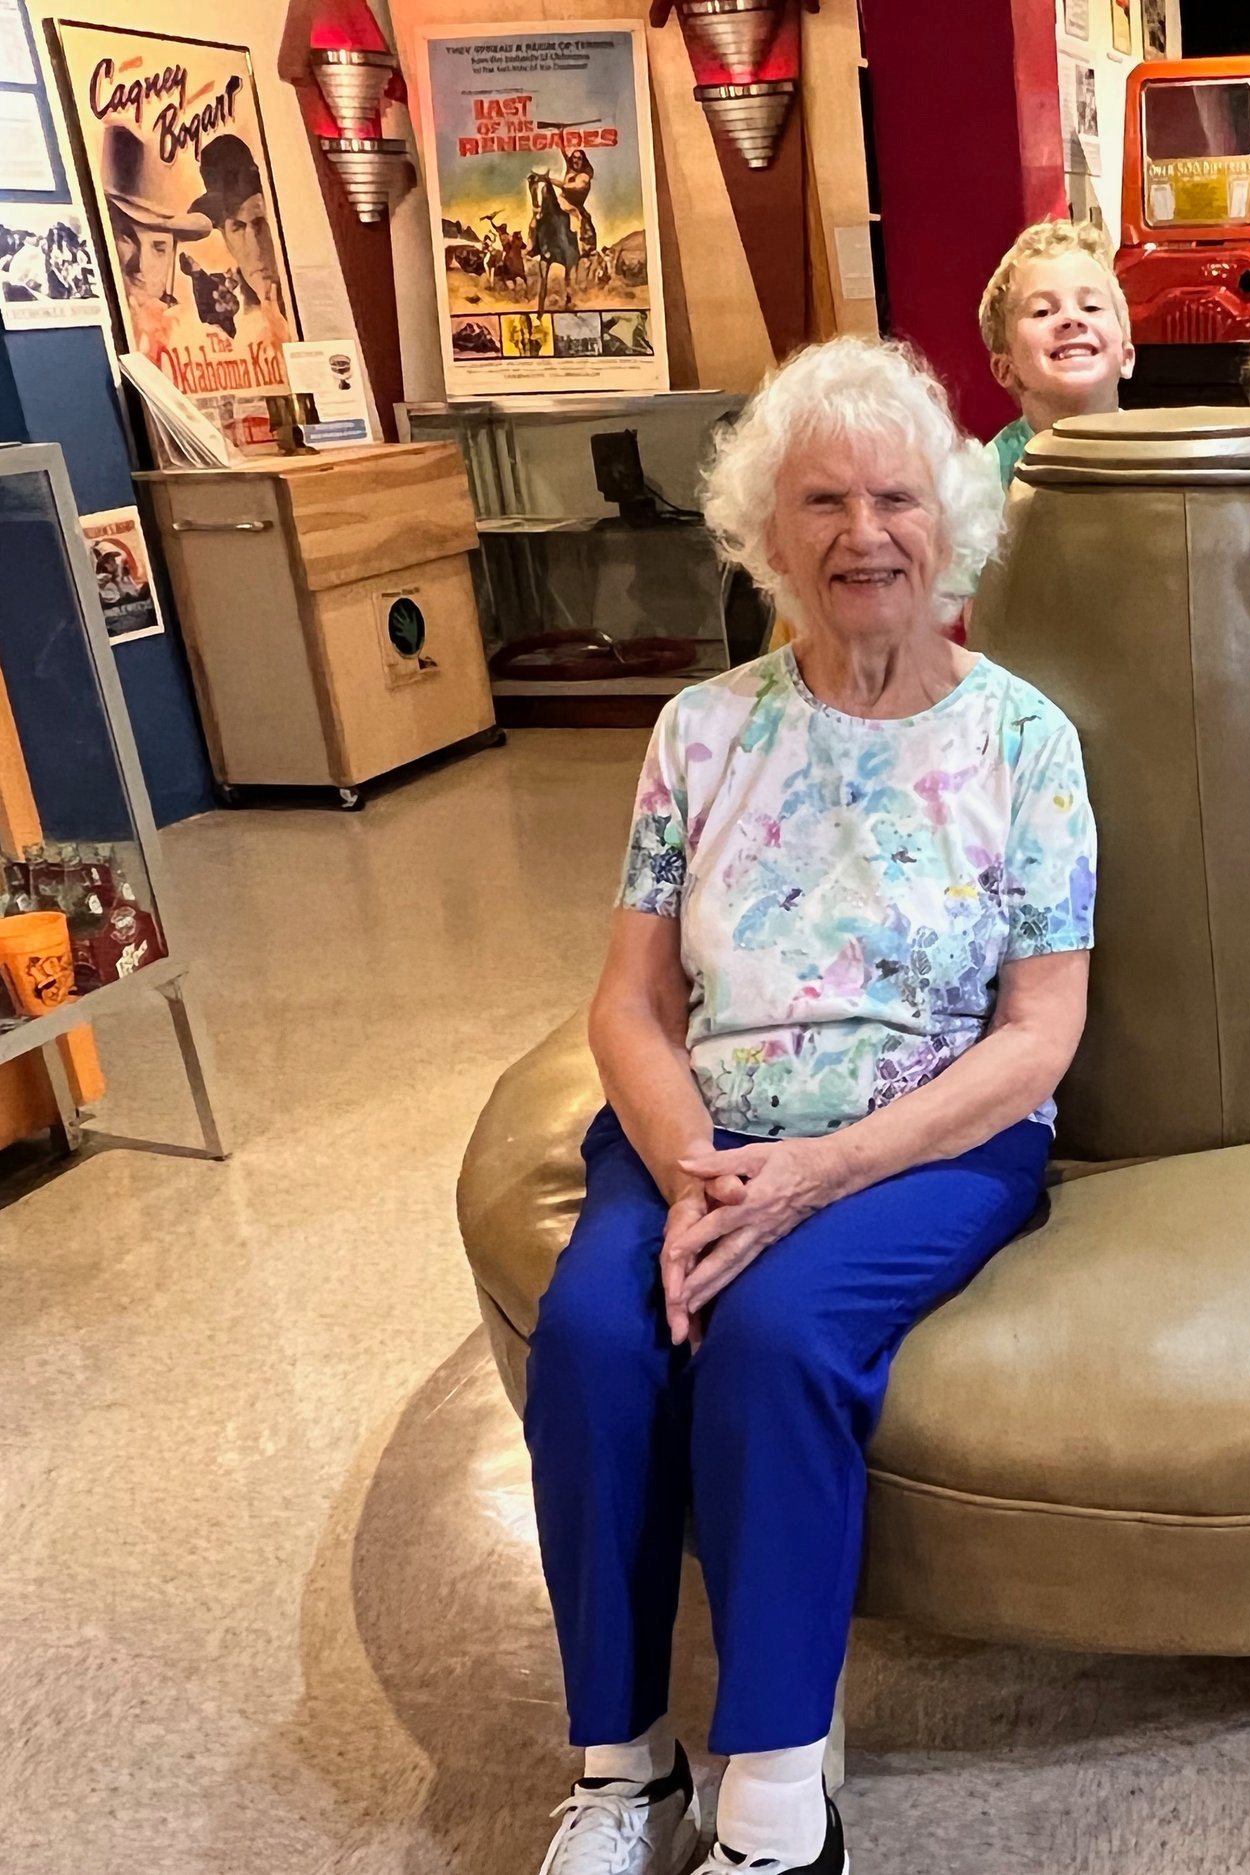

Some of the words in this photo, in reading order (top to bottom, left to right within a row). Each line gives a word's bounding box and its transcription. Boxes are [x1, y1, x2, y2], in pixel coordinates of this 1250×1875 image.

[89, 58, 188, 124] Cagney
[152, 75, 243, 164] Bogart
[473, 96, 533, 121] LAST
[458, 128, 618, 157] RENEGADES
[477, 121, 501, 136] OF
[206, 332, 234, 353] The
[155, 344, 252, 395] Oklahoma
[248, 341, 285, 387] Kid
